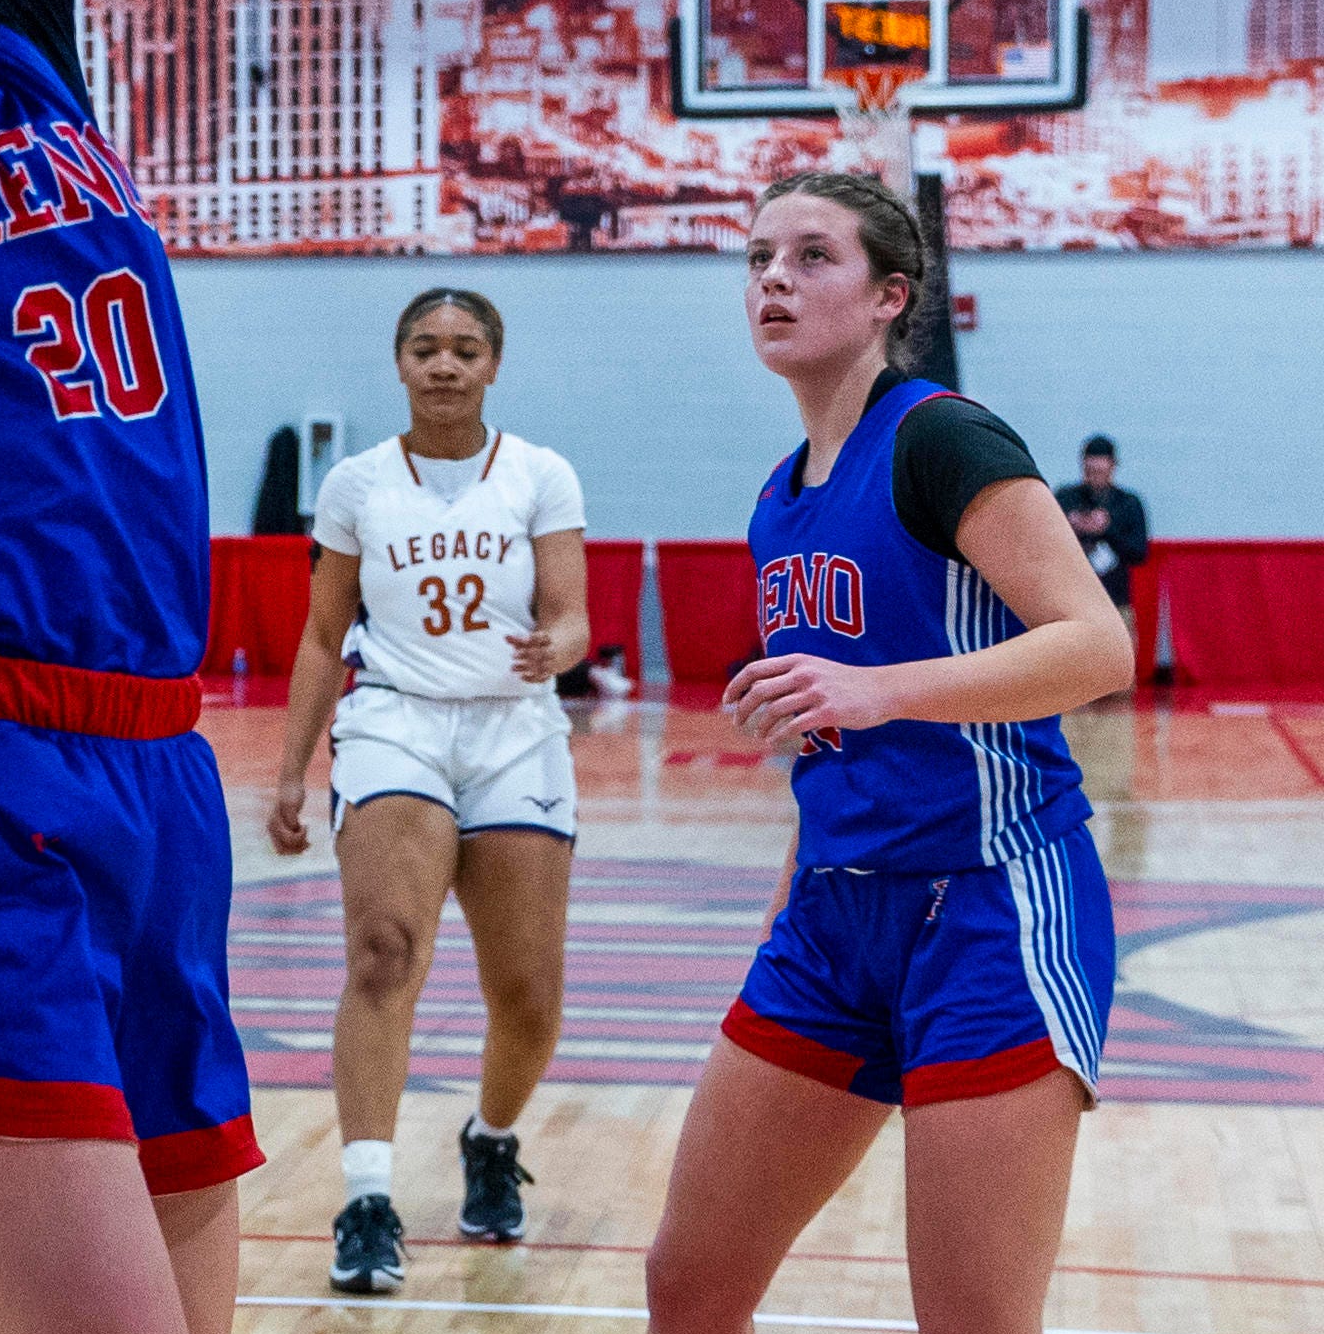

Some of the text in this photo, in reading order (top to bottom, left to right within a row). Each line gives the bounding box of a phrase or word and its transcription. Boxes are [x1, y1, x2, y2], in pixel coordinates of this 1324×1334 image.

[13, 267, 168, 422] 20
[387, 529, 512, 572] LEGACY
[418, 574, 490, 637] 32
[756, 552, 866, 640] ENO
